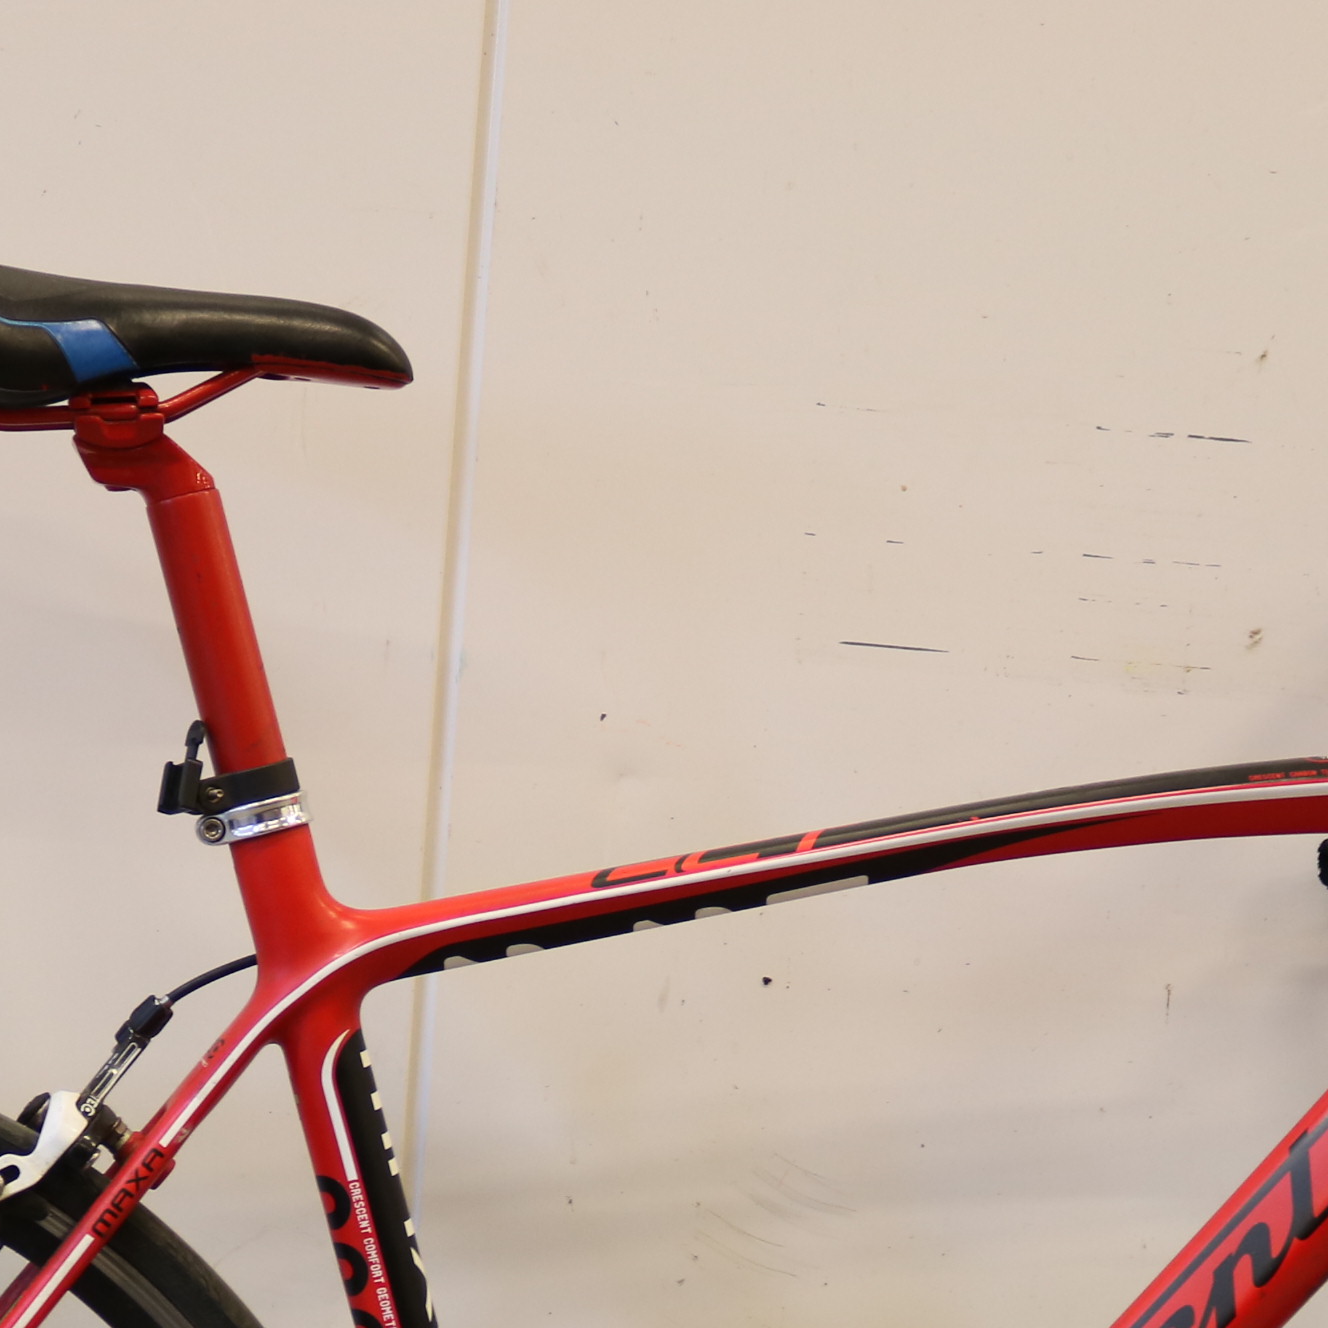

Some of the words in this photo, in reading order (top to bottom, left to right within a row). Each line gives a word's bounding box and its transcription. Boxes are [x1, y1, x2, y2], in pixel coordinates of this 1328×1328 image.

[91, 1147, 165, 1238] MAXA
[349, 1182, 372, 1233] CRESCENT
[363, 1237, 384, 1284] COMFORT
